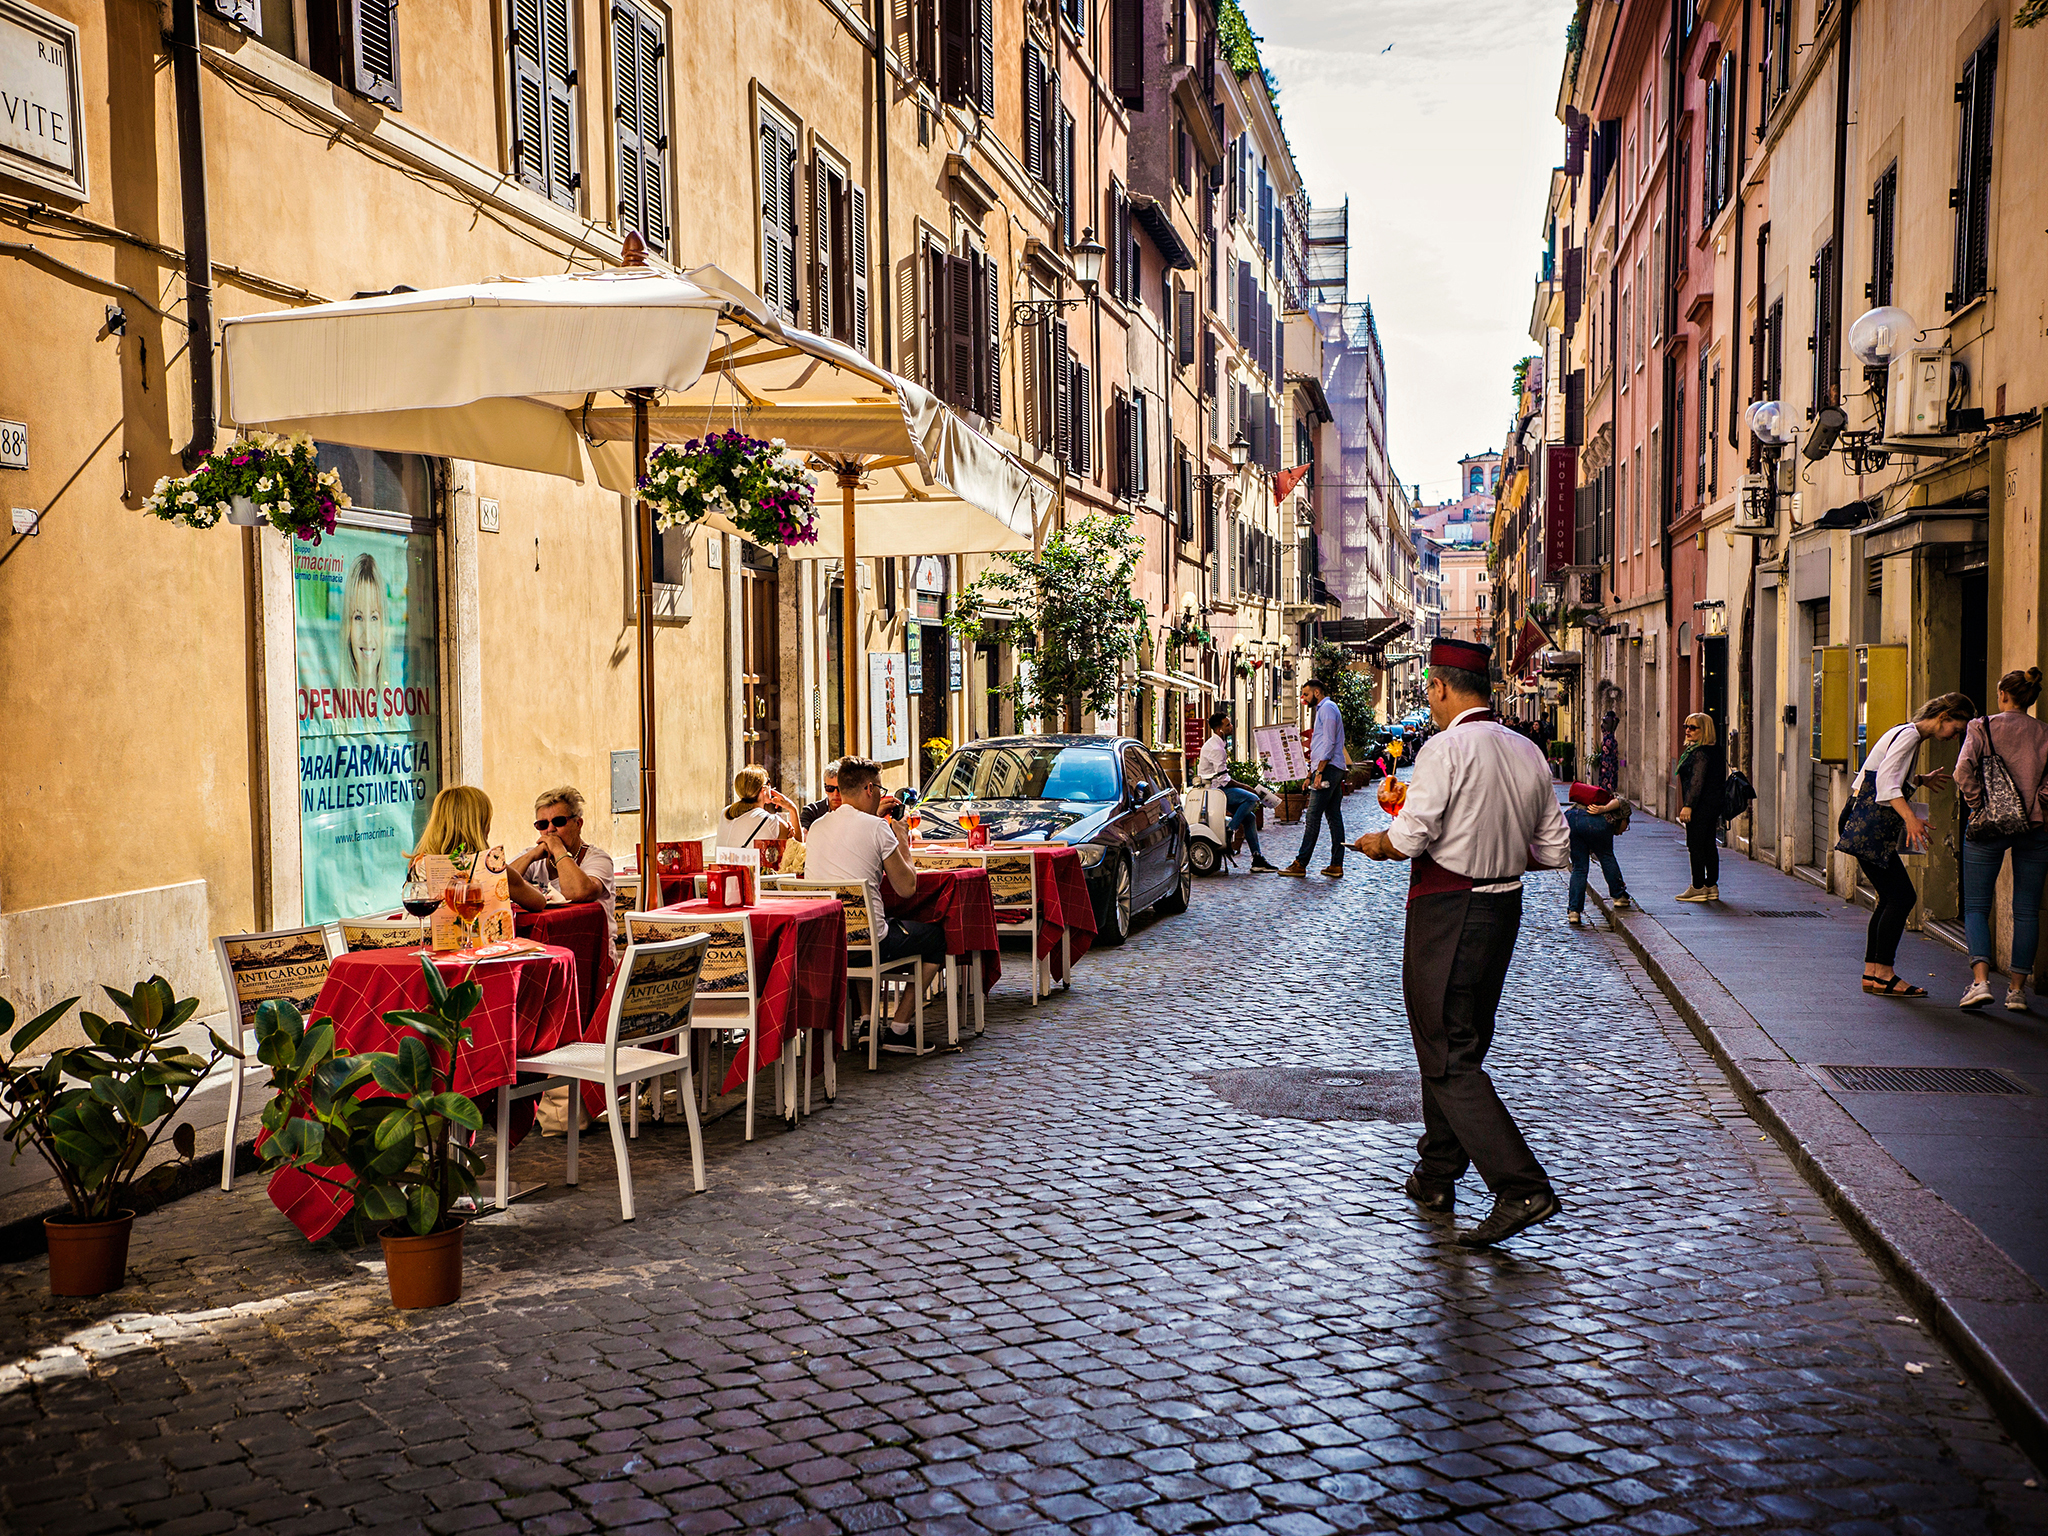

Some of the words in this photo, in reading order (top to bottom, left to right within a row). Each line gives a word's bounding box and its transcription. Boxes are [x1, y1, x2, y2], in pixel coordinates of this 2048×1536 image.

[37, 41, 63, 67] R.III
[1, 91, 67, 145] VITE
[1558, 461, 1566, 512] HOTEL
[483, 503, 498, 526] 89
[1556, 520, 1564, 560] HOMS
[294, 554, 344, 572] rmacrimi
[298, 688, 378, 721] OPENING
[383, 687, 430, 717] SOON
[301, 788, 314, 812] IN
[317, 778, 426, 811] ALLESTIMENTO
[335, 827, 395, 844] www.farmacrimi.it
[237, 963, 329, 984] ANTICAROMA
